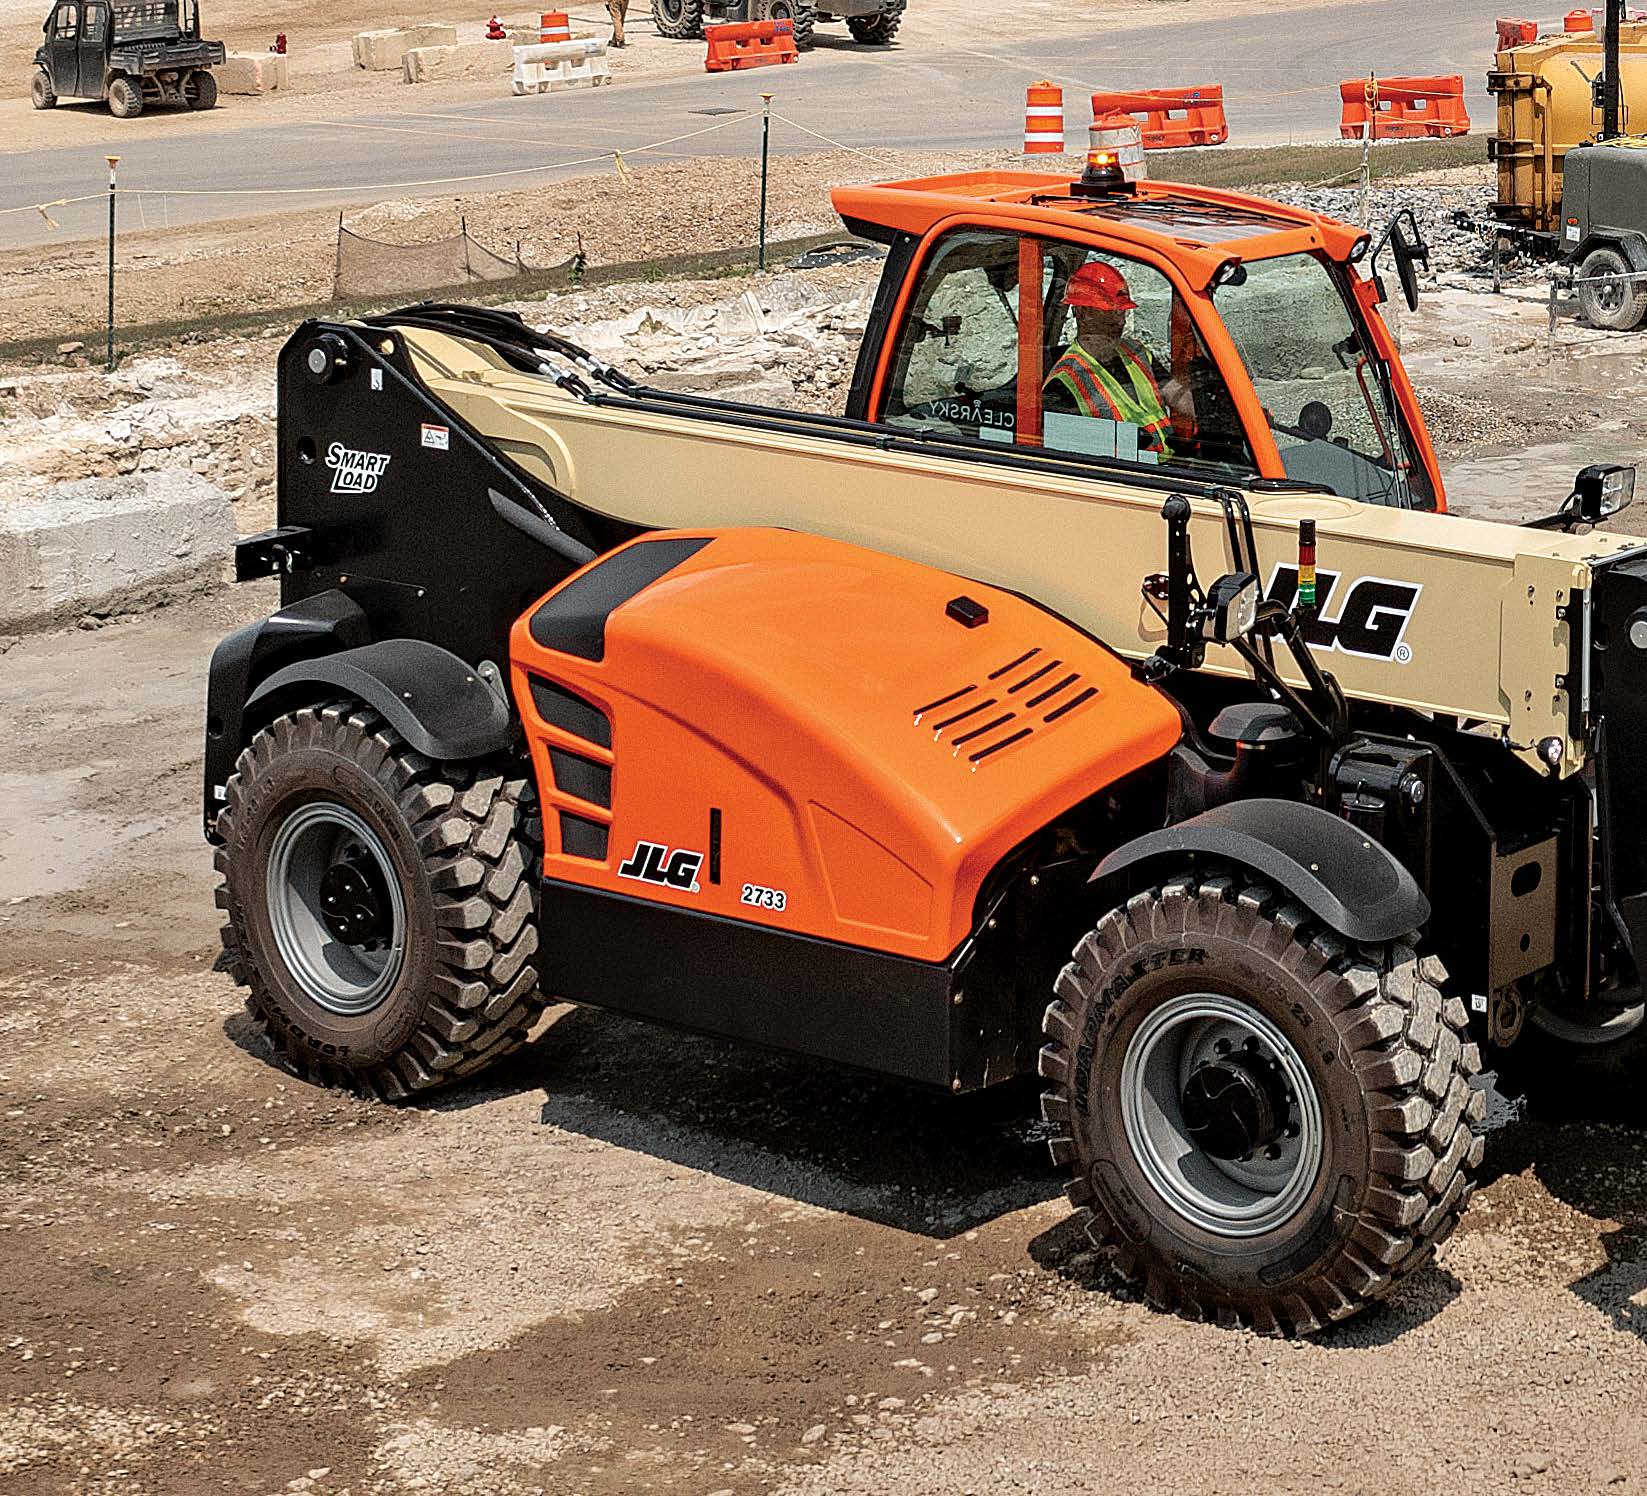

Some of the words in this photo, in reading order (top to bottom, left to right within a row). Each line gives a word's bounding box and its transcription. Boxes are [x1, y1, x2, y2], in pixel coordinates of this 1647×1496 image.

[326, 443, 389, 474] SMART
[332, 468, 377, 492] LOAD
[618, 841, 703, 891] JLG
[741, 884, 787, 911] 2733
